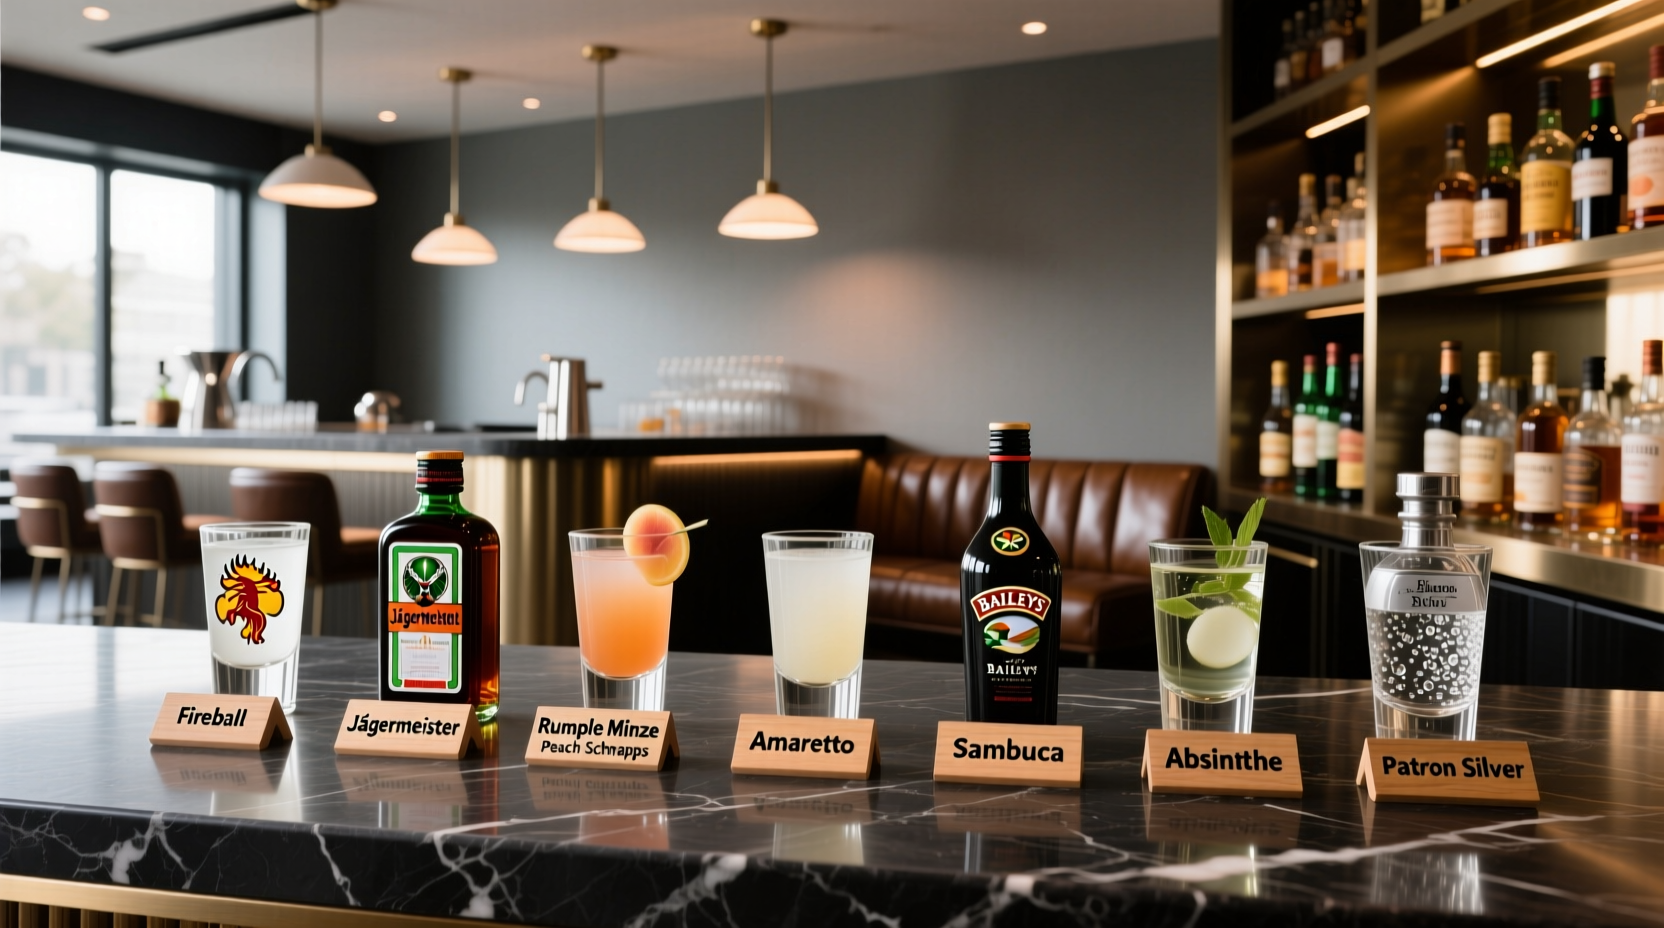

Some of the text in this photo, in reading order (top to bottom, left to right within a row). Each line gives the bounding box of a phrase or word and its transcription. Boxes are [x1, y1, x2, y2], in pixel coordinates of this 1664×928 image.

[978, 591, 1046, 613] BAILEYS
[177, 706, 248, 727] Fireball
[538, 717, 660, 740] Rumple Minze
[541, 740, 581, 754] Peach
[749, 731, 855, 754] Amaretto
[953, 737, 1064, 762] Sambuca
[1382, 756, 1525, 779] Patron Silver
